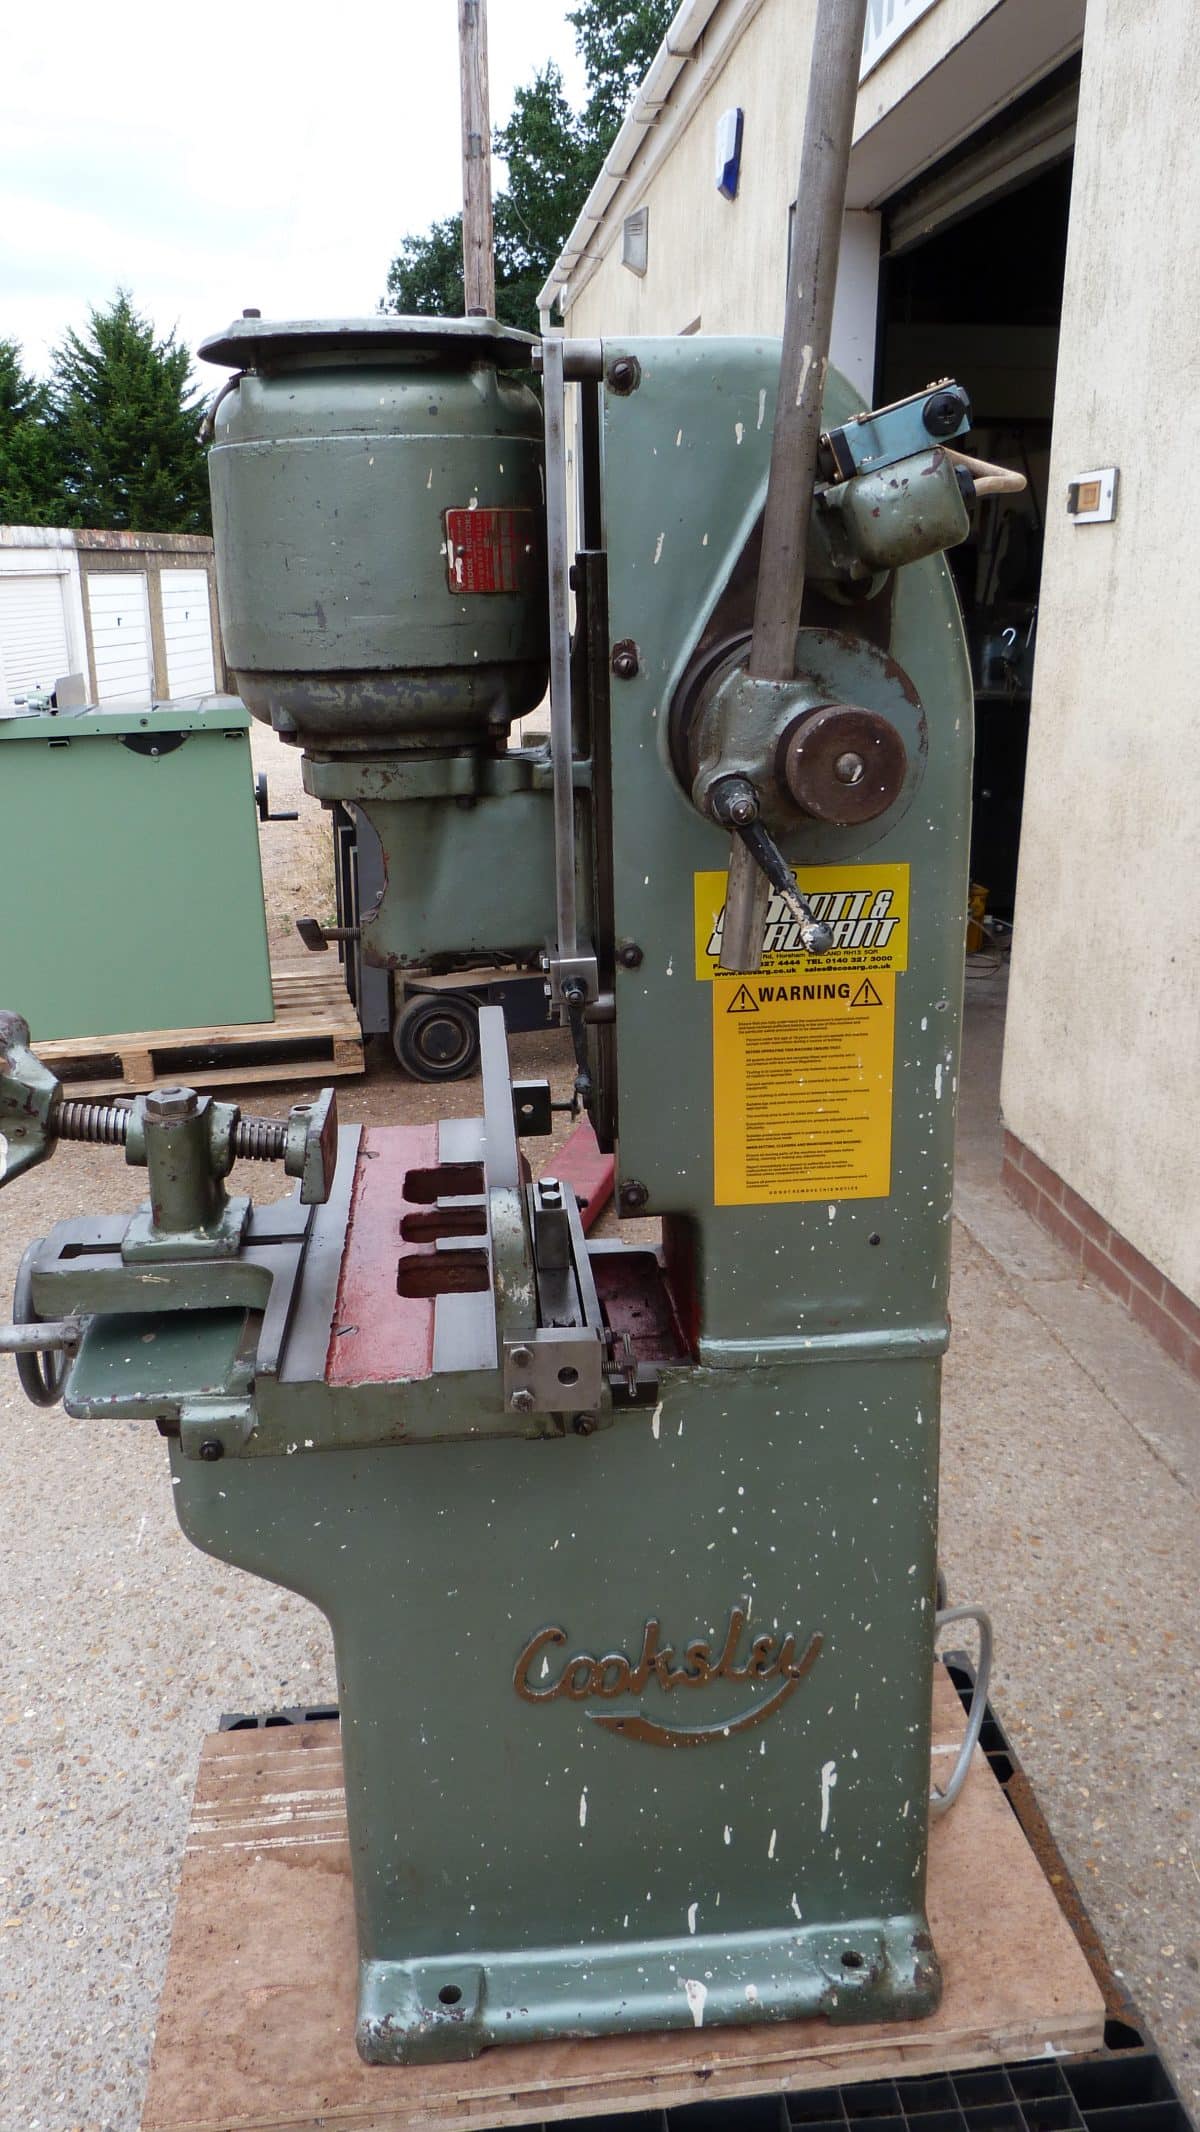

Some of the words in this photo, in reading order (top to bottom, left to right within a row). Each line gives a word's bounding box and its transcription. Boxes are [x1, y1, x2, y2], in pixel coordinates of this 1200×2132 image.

[869, 889, 894, 920] &
[850, 955, 867, 963] 327
[758, 983, 851, 1002] WARNING
[512, 1604, 825, 1748] Cooksley
